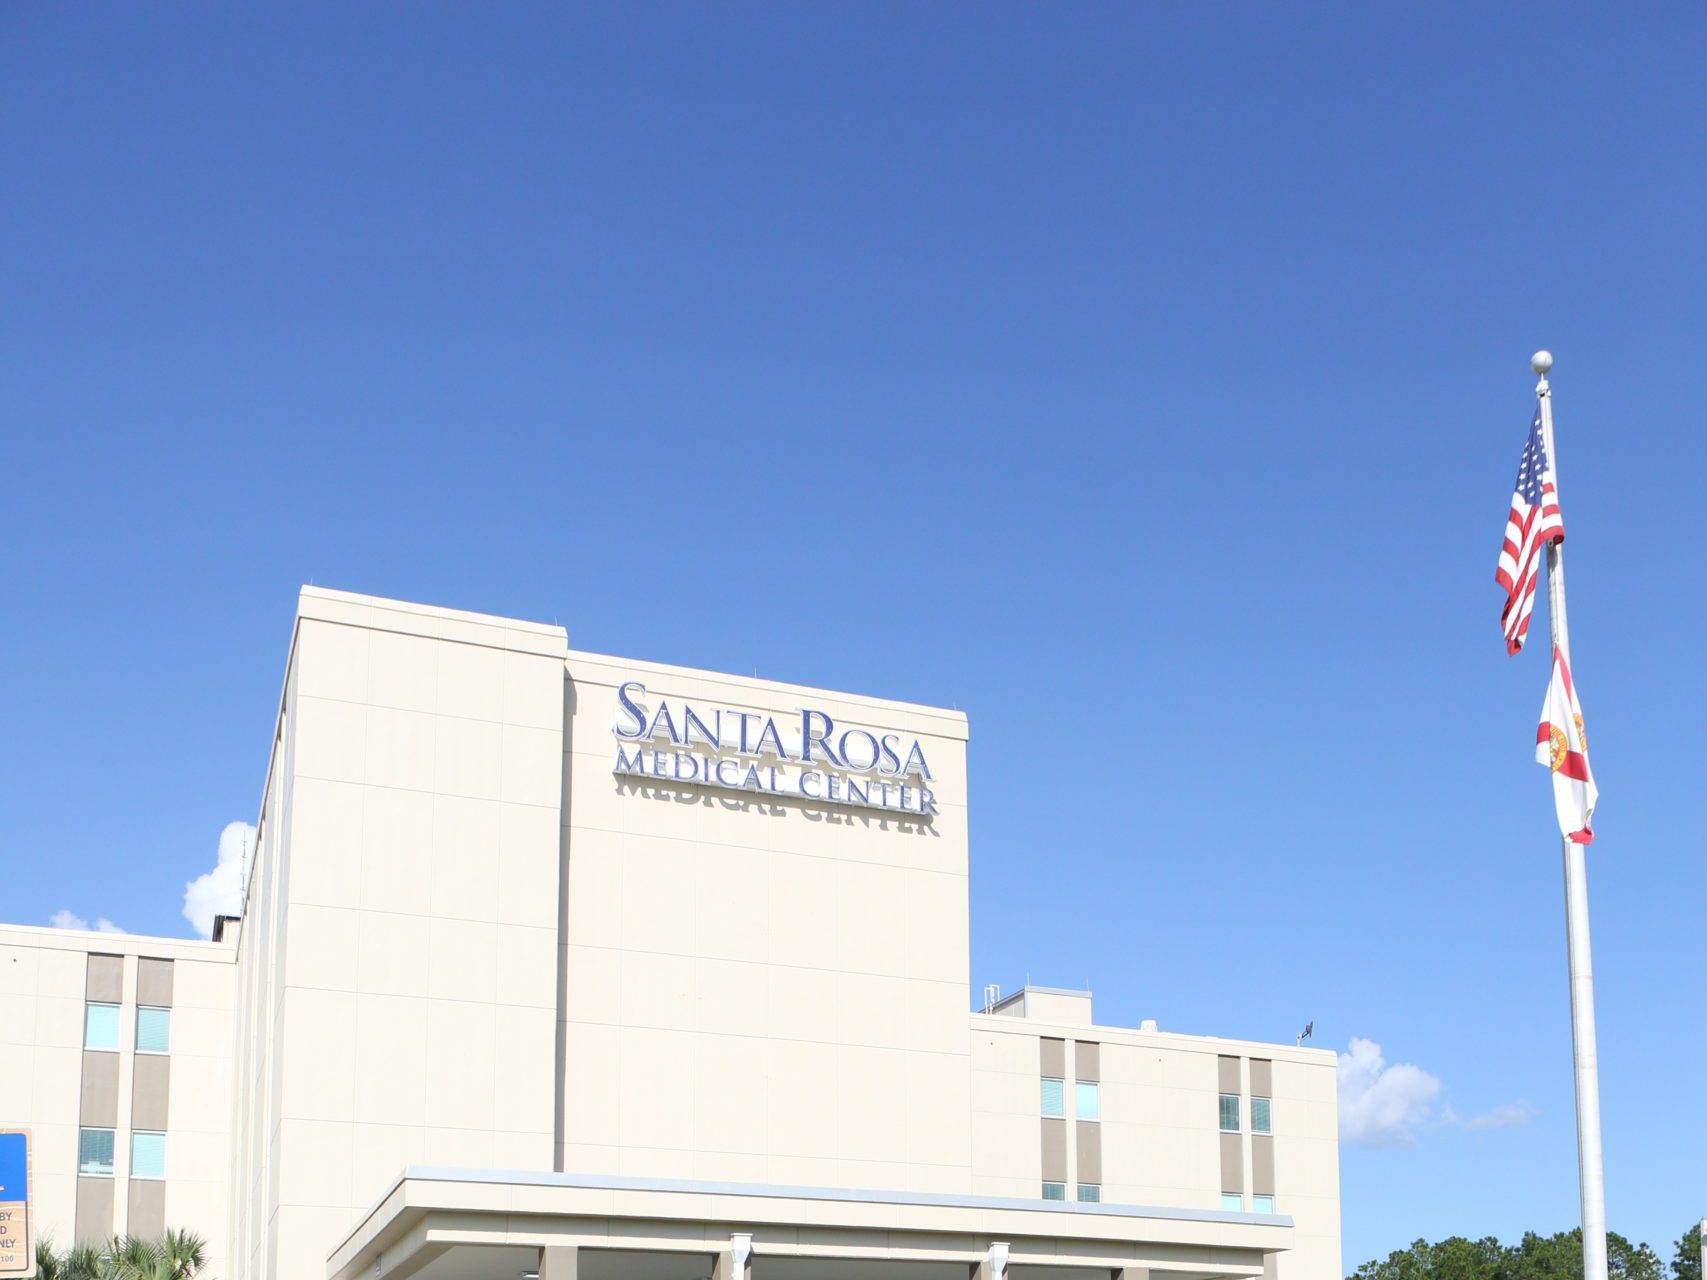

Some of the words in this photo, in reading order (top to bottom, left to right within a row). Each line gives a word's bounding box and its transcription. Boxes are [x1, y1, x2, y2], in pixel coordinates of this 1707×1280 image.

[615, 681, 790, 762] SANTA
[799, 708, 935, 780] ROSA
[614, 745, 786, 793] MEDICAL
[798, 769, 939, 815] CENTER
[0, 1212, 12, 1221] BY
